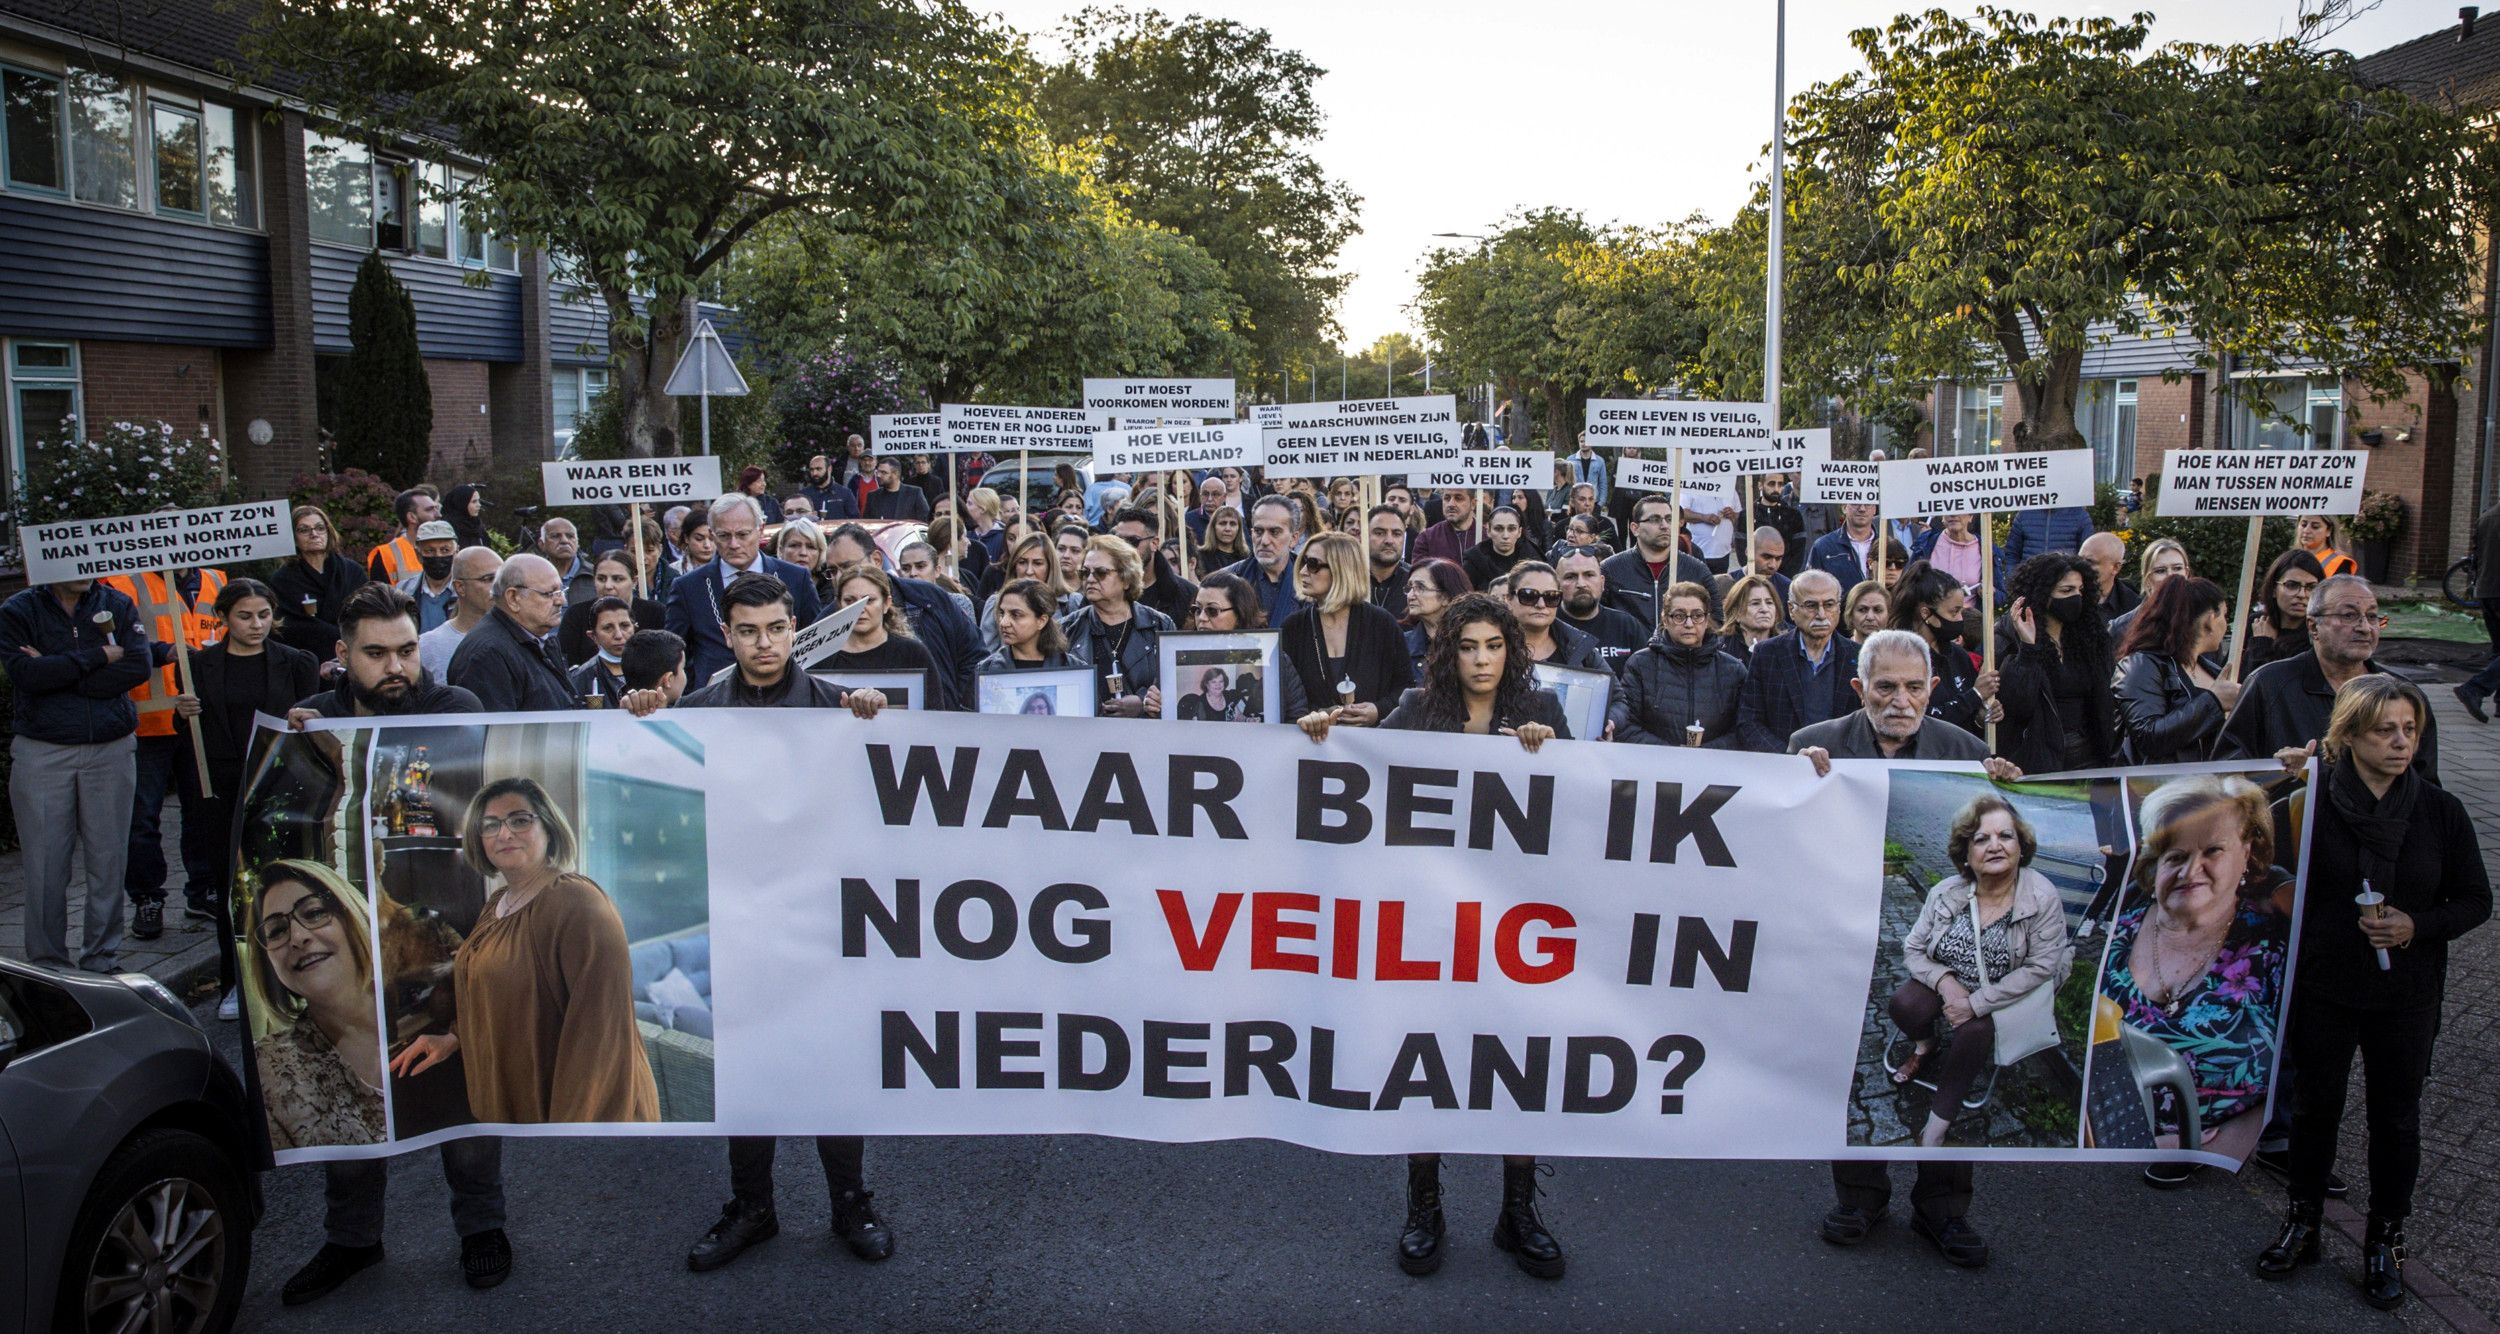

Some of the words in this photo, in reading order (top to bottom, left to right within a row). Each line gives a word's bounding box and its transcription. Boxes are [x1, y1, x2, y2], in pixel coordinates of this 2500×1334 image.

[1125, 386, 1145, 394] DIT
[1149, 385, 1192, 394] MOEST
[1089, 399, 1167, 408] VOORKOMEN
[1173, 399, 1229, 408] WORDEN!
[1339, 401, 1399, 413] HOEVEEL
[964, 408, 1021, 418] HOEVEEL
[1026, 410, 1085, 421] ANDEREN
[1288, 414, 1416, 428] WAARSCHUWINGEN
[1420, 412, 1450, 422] ZIJN
[1599, 410, 1637, 420] GEEN
[1642, 411, 1687, 421] LEVEN
[1693, 412, 1705, 422] IS
[1710, 413, 1761, 425] VEILIG,
[879, 429, 928, 438] MOETEN
[948, 420, 1000, 431] MOETEN
[1005, 423, 1020, 432] ER
[1025, 423, 1052, 433] NOG
[1056, 425, 1101, 434] LIJDEN
[1589, 425, 1619, 435] OOK
[1625, 426, 1657, 435] NIET
[1662, 426, 1676, 436] IN
[1681, 427, 1769, 438] NEDERLAND!
[954, 434, 996, 444] ONDER
[1001, 436, 1025, 445] HET
[1030, 437, 1093, 448] SYSTEEM?
[1128, 434, 1162, 447] HOE
[1168, 431, 1224, 444] VEILIG
[1277, 437, 1317, 448] GEEN
[1322, 435, 1370, 447] LEVEN
[1375, 435, 1389, 445] IS
[1394, 433, 1447, 445] VEILIG,
[1788, 437, 1806, 449] IK
[885, 442, 926, 451] ONDER
[1111, 454, 1126, 465] IS
[1132, 447, 1243, 464] NEDERLAND?
[1268, 454, 1299, 465] OOK
[1305, 452, 1339, 463] NIET
[1344, 452, 1358, 462] IN
[1364, 448, 1458, 461] NEDERLAND!
[1480, 457, 1510, 468] BEN
[1516, 457, 1532, 468] IK
[2178, 455, 2212, 468] HOE
[2216, 456, 2250, 469] KAN
[2254, 456, 2285, 469] HET
[2289, 456, 2318, 469] DAT
[566, 466, 622, 480] WAAR
[628, 464, 666, 478] BEN
[673, 463, 693, 476] IK
[1642, 464, 1667, 474] HOE
[1693, 460, 1730, 474] NOG
[1736, 456, 1803, 471] VEILIG?
[1821, 464, 1878, 474] WAAROM
[1926, 460, 1998, 475] WAAROM
[2004, 457, 2048, 470] TWEE
[1431, 473, 1464, 484] NOG
[1470, 474, 1529, 485] VEILIG?
[1628, 475, 1639, 483] IS
[1817, 477, 1853, 487] LIEVE
[1930, 475, 2046, 494] ONSCHULDIGE
[2174, 476, 2210, 489] MAN
[2216, 476, 2277, 489] TUSSEN
[2281, 476, 2353, 489] NORMALE
[572, 486, 613, 499] NOG
[618, 483, 691, 497] VEILIG?
[1821, 491, 1862, 500] LEVEN
[1918, 499, 1964, 513] LIEVE
[1969, 493, 2058, 509] VROUWEN?
[2195, 497, 2261, 510] MENSEN
[2266, 496, 2328, 510] WOONT?
[39, 526, 83, 541] HOE
[90, 521, 134, 536] KAN
[141, 516, 180, 531] HET
[187, 511, 223, 526] DAT
[42, 544, 89, 560] MAN
[94, 534, 177, 554] TUSSEN
[184, 523, 278, 544] NORMALE
[77, 554, 163, 575] MENSEN
[169, 544, 252, 565] WOONT?
[826, 621, 853, 642] ZIJN
[1593, 646, 1618, 657] ER
[866, 744, 1248, 839] WAAR
[1296, 759, 1554, 855] BEN
[1605, 780, 1741, 868] IK
[841, 878, 1111, 963] NOG
[1156, 890, 1576, 984] VEILIG
[1626, 913, 1758, 992] IN
[881, 1011, 1705, 1114] NEDERLAND?
